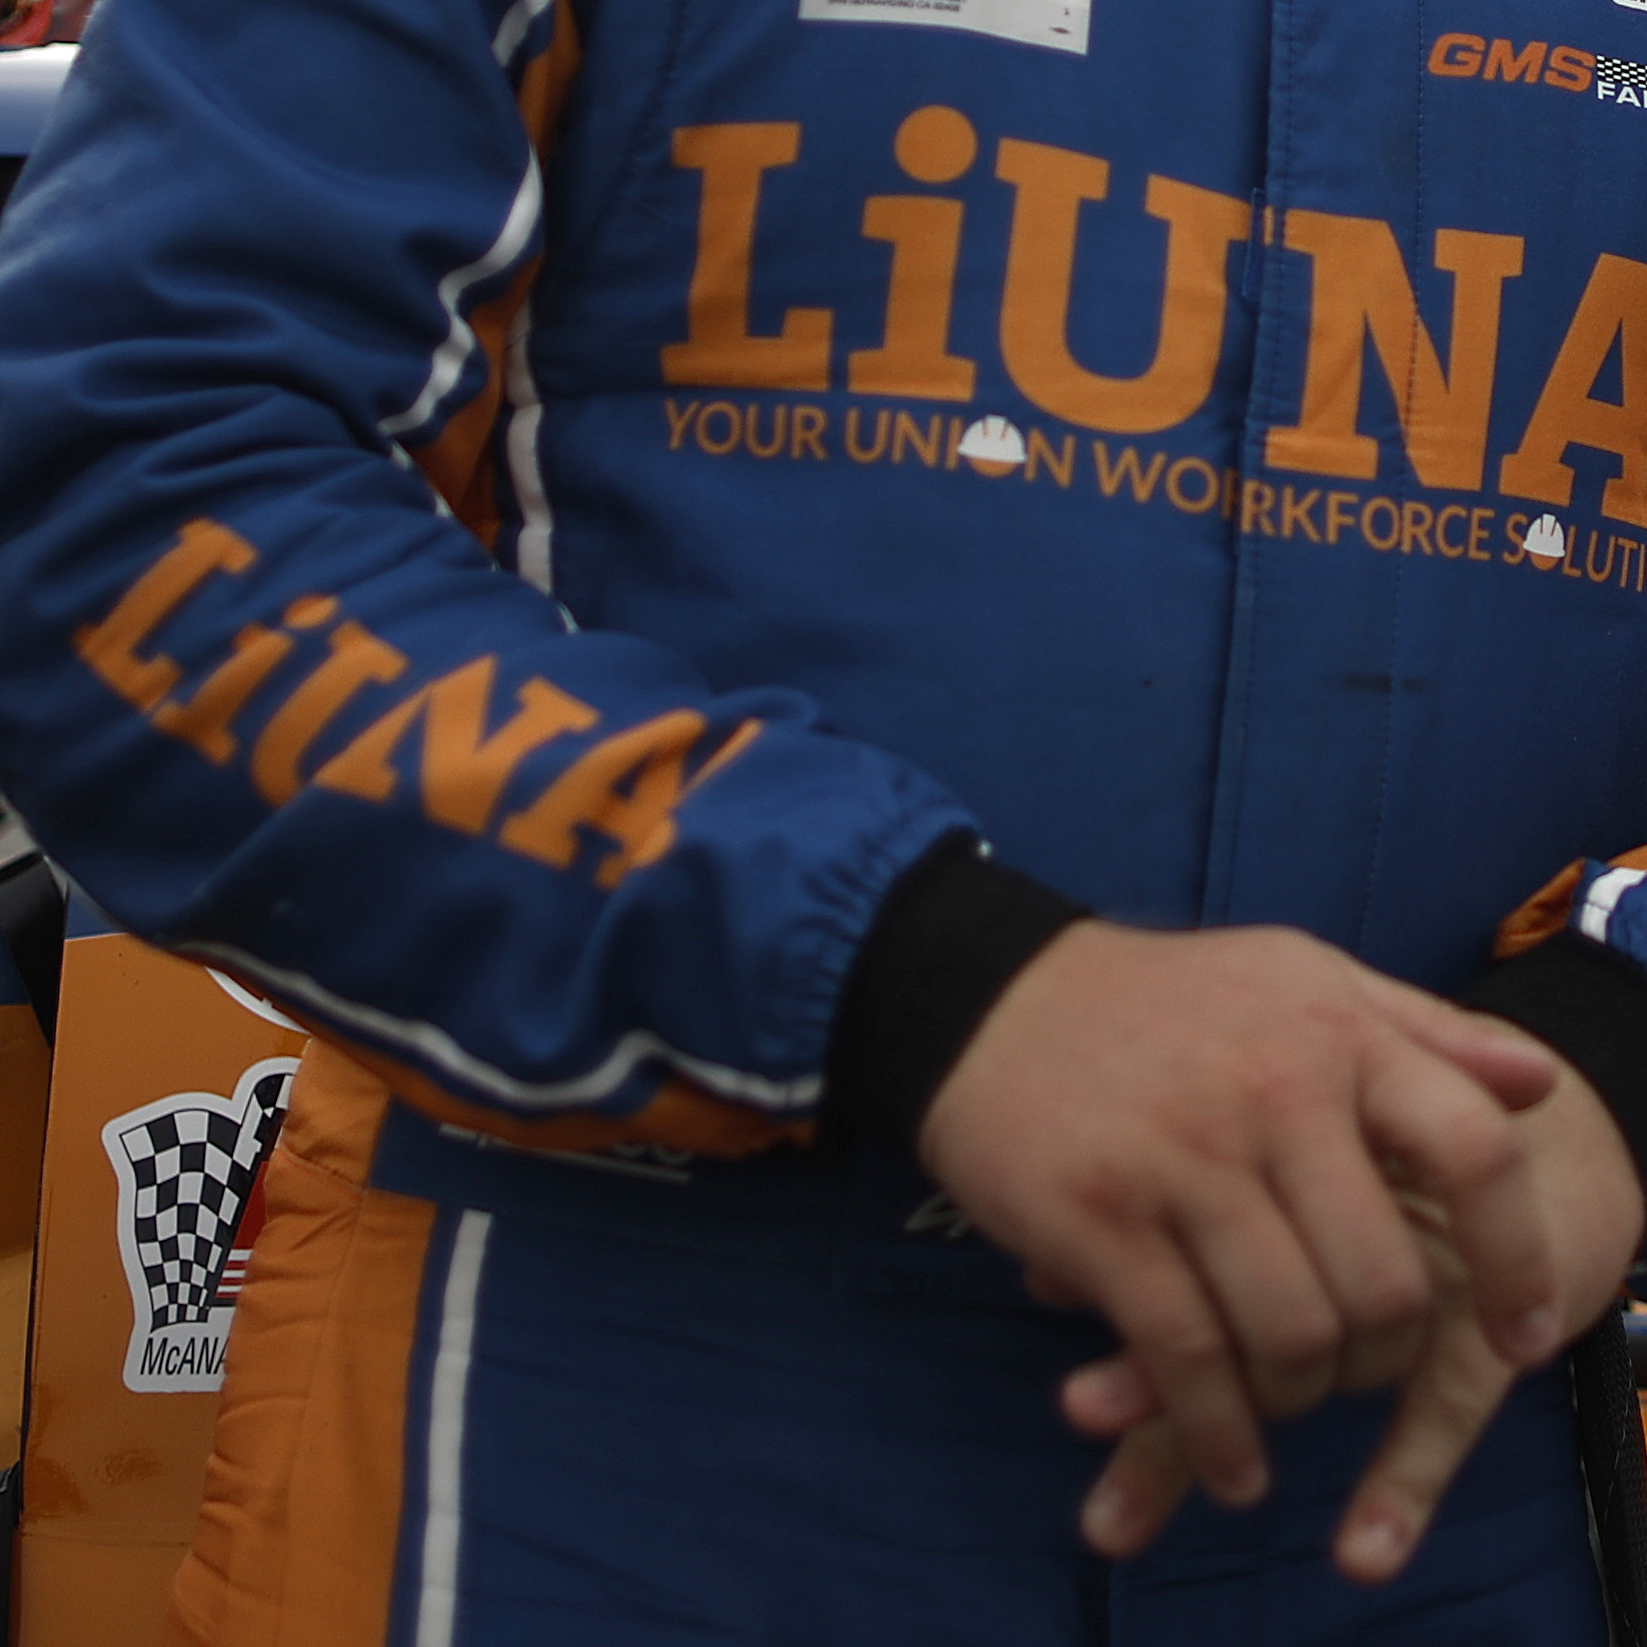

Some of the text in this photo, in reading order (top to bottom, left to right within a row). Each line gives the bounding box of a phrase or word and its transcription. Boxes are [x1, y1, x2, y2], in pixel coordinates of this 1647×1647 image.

[1427, 32, 1598, 92] GMS
[664, 399, 828, 460] YOUR
[1092, 439, 1494, 560] WORKFORCE
